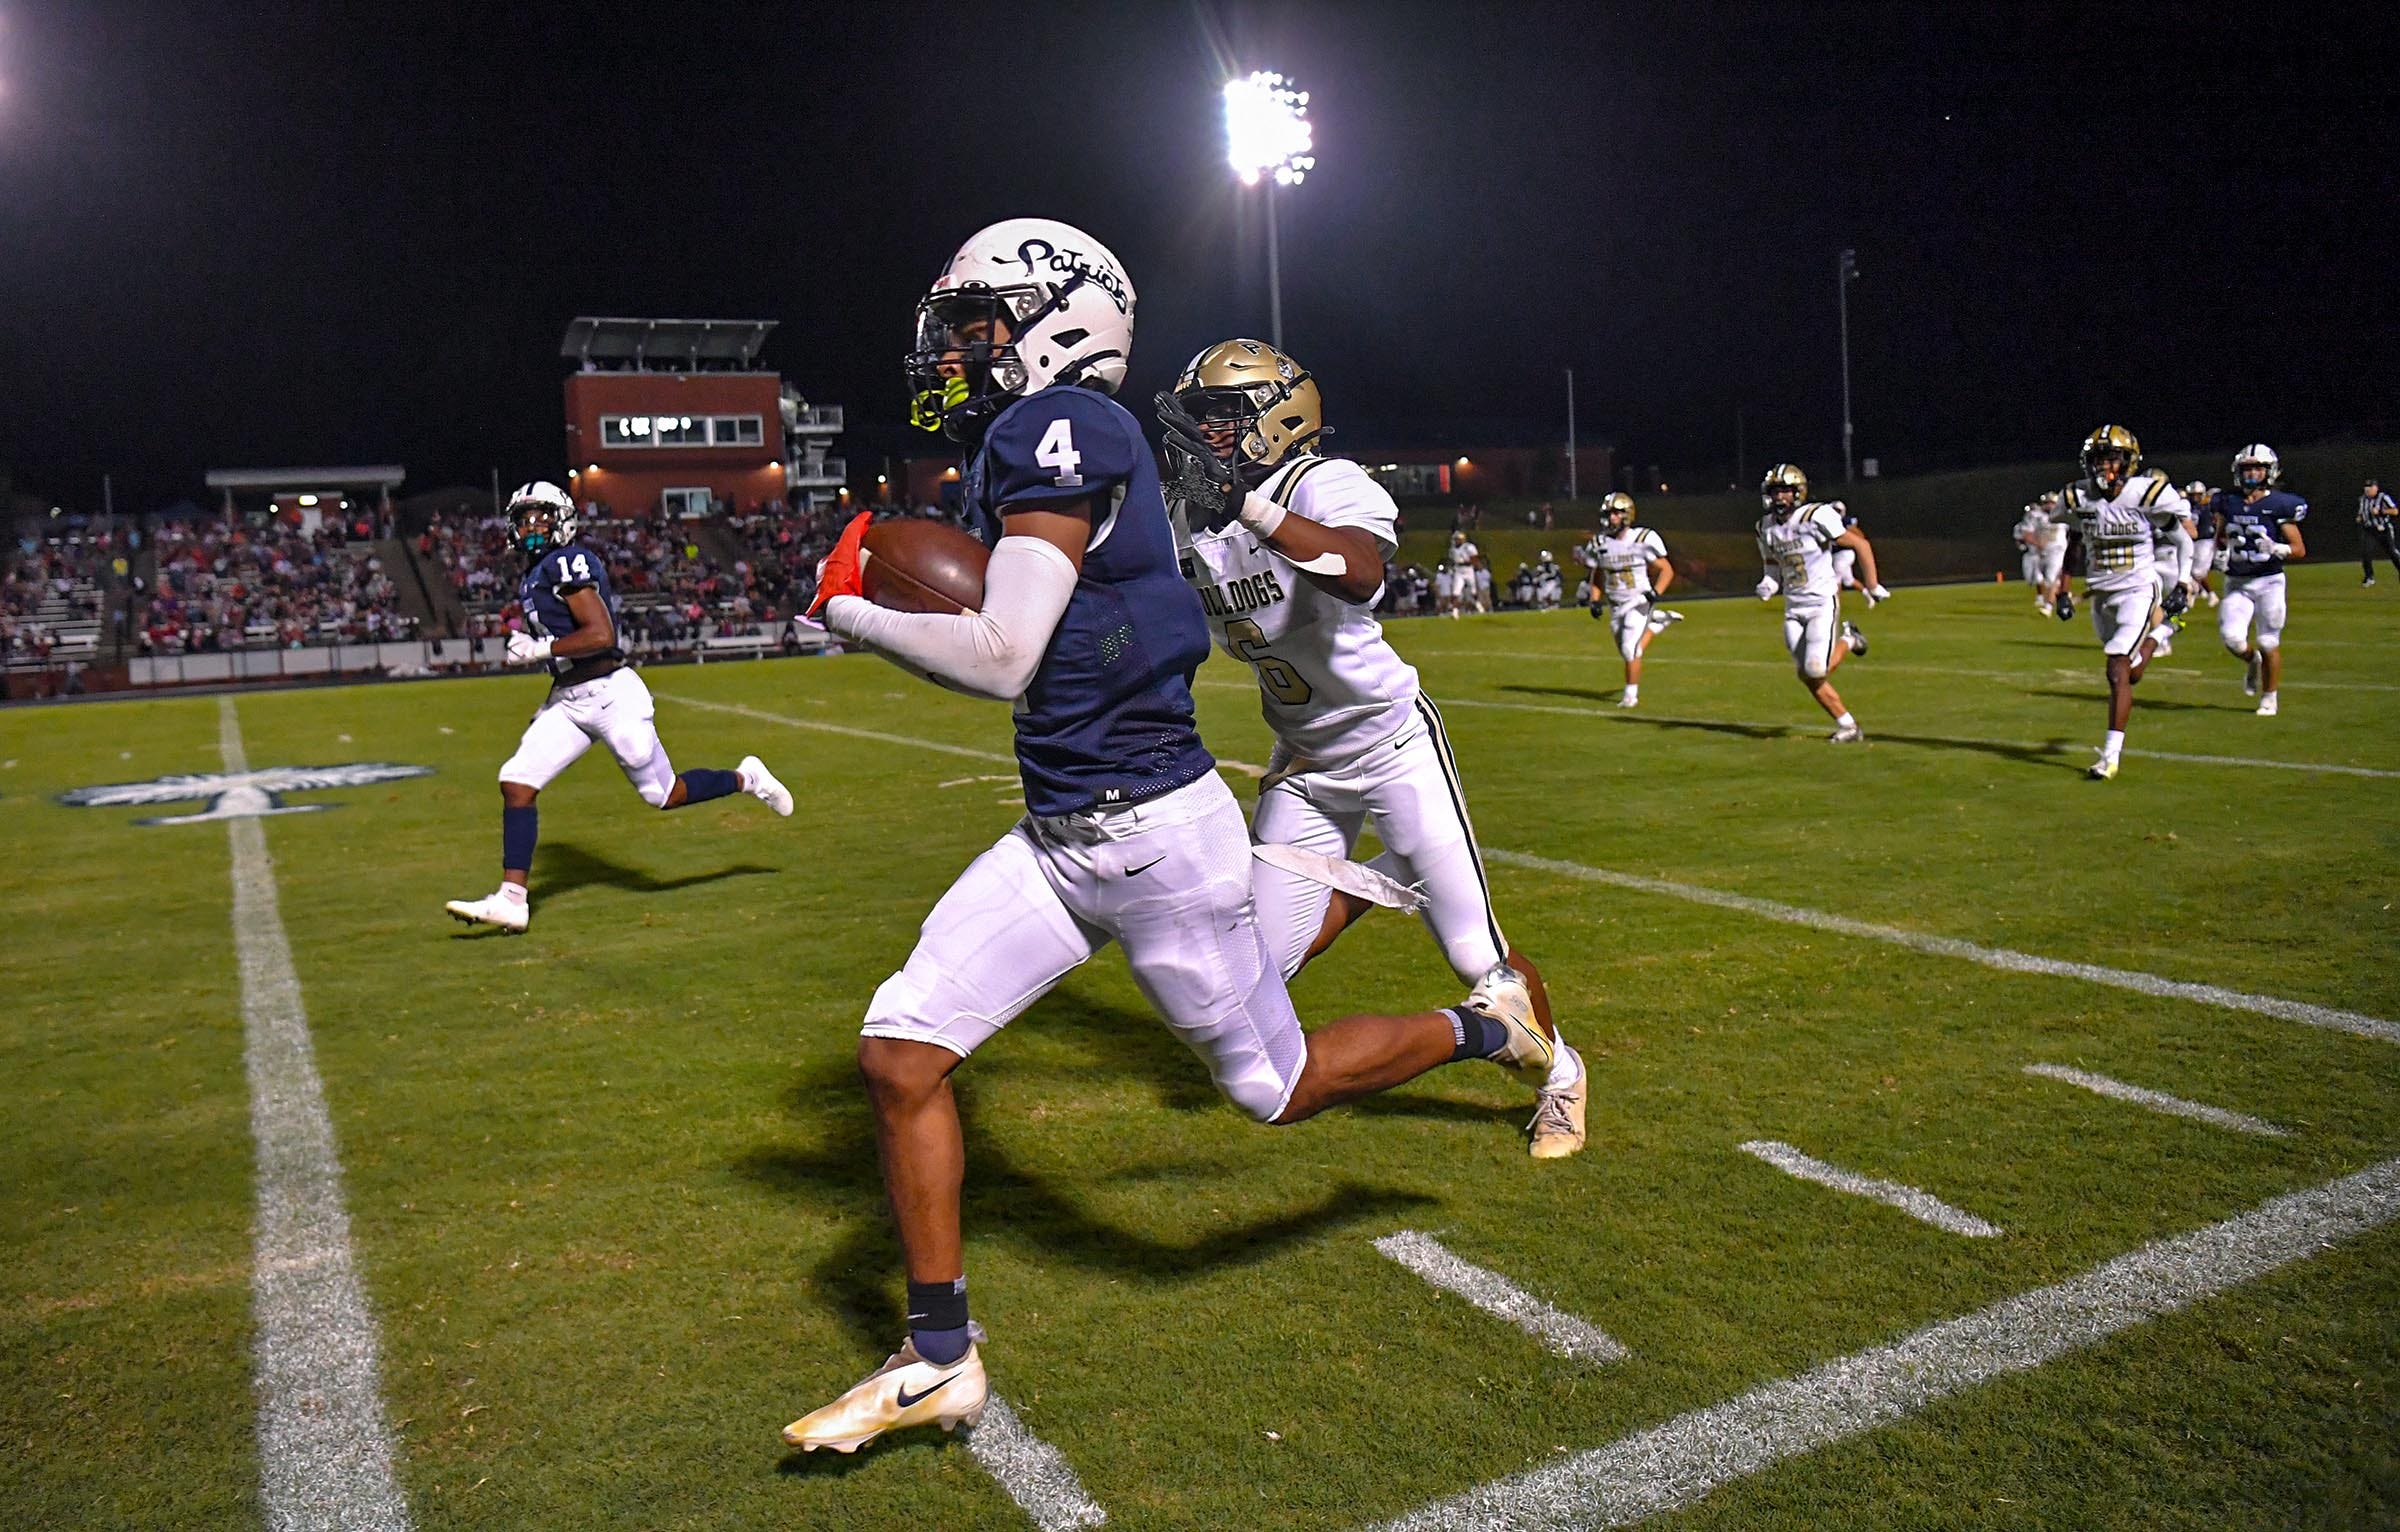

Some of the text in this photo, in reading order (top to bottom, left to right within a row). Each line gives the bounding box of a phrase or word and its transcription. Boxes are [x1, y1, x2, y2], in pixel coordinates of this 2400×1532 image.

[1034, 418, 1081, 487] 4
[2083, 521, 2139, 536] LLDOGS
[556, 553, 591, 583] 14
[1196, 569, 1286, 617] ULLDOGS
[1224, 617, 1313, 705] 6
[1105, 788, 1120, 801] M
